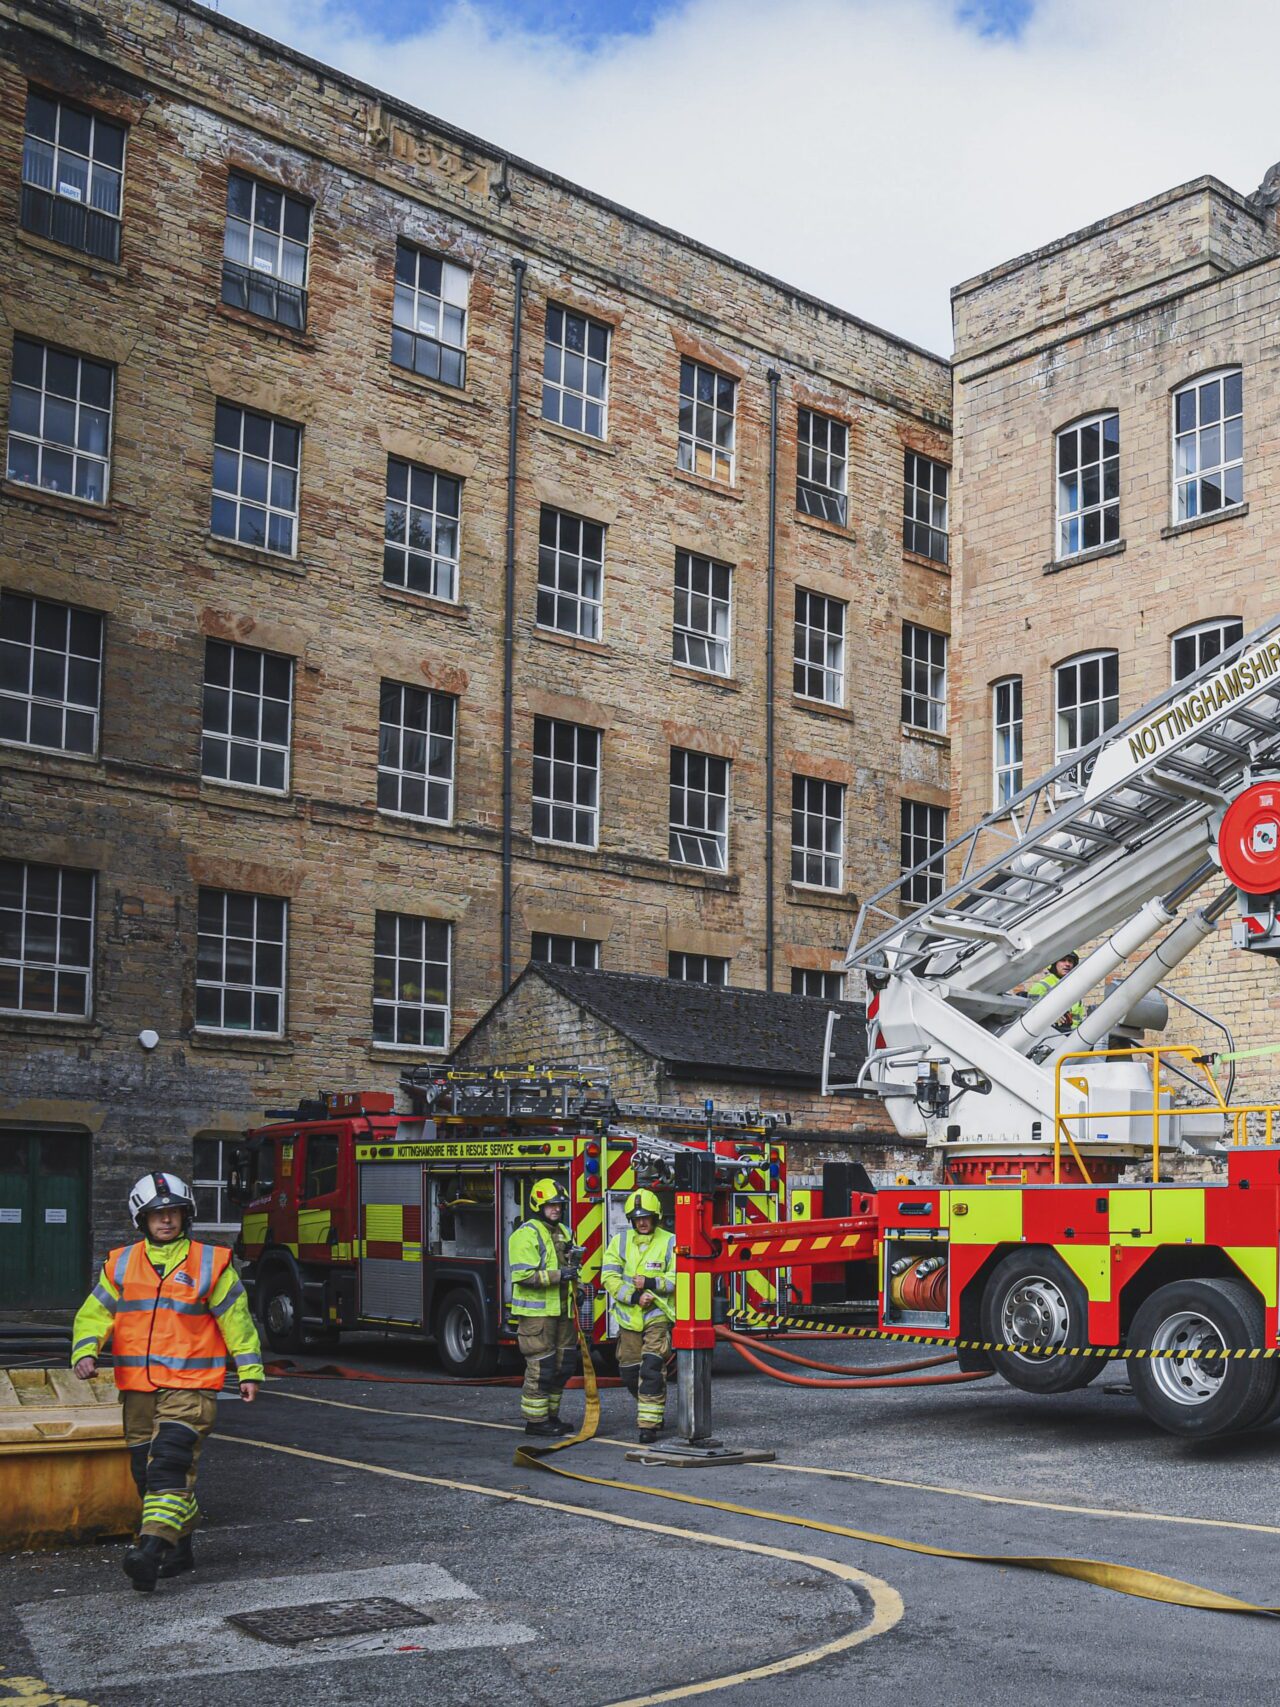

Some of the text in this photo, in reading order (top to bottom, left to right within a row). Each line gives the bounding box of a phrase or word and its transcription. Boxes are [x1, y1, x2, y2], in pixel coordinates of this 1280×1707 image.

[400, 135, 479, 184] 1847
[397, 1145, 444, 1157] NOTTINGHAMSHIRE
[446, 1144, 459, 1156] FIRE
[465, 1144, 488, 1156] RESCUE
[490, 1144, 513, 1155] SERVICE
